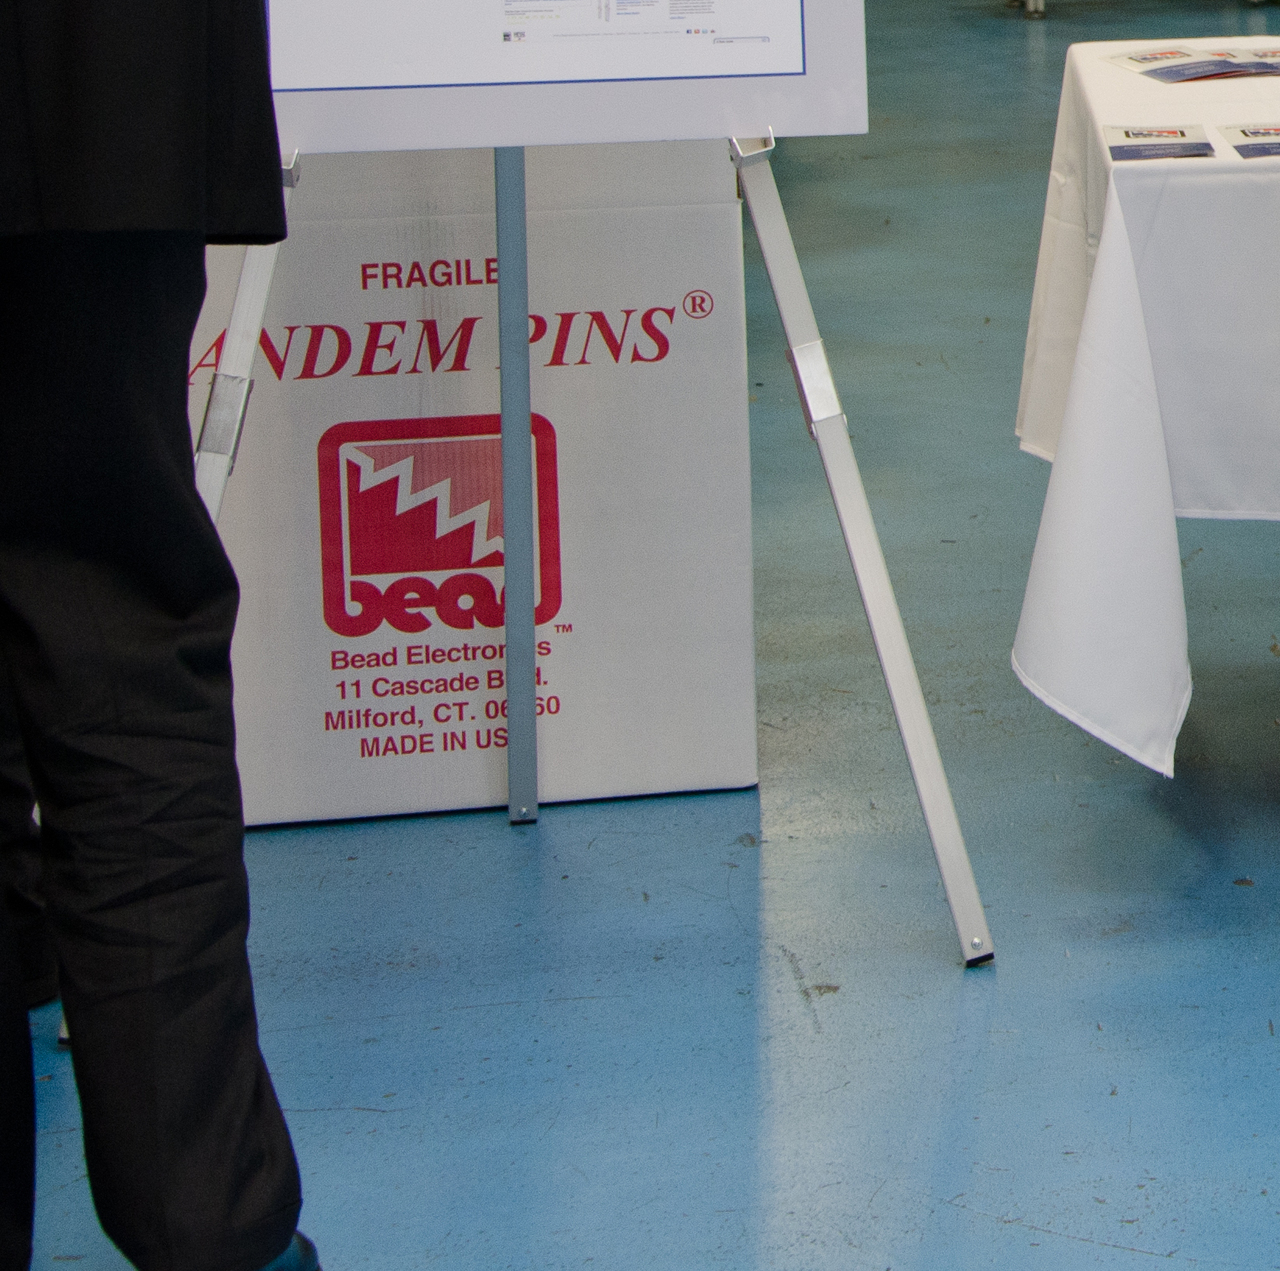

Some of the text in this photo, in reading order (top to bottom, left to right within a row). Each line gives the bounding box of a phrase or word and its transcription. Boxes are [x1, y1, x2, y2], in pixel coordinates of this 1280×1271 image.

[360, 257, 498, 290] FRAGILE
[187, 316, 483, 384] ANDEM
[496, 306, 676, 369] INS
[331, 641, 552, 670] Bead Electros
[336, 680, 361, 700] 11
[371, 673, 479, 698] Cascade
[324, 705, 424, 731] Milford,
[433, 702, 476, 725] CT.
[360, 727, 509, 758] MADE IN US
